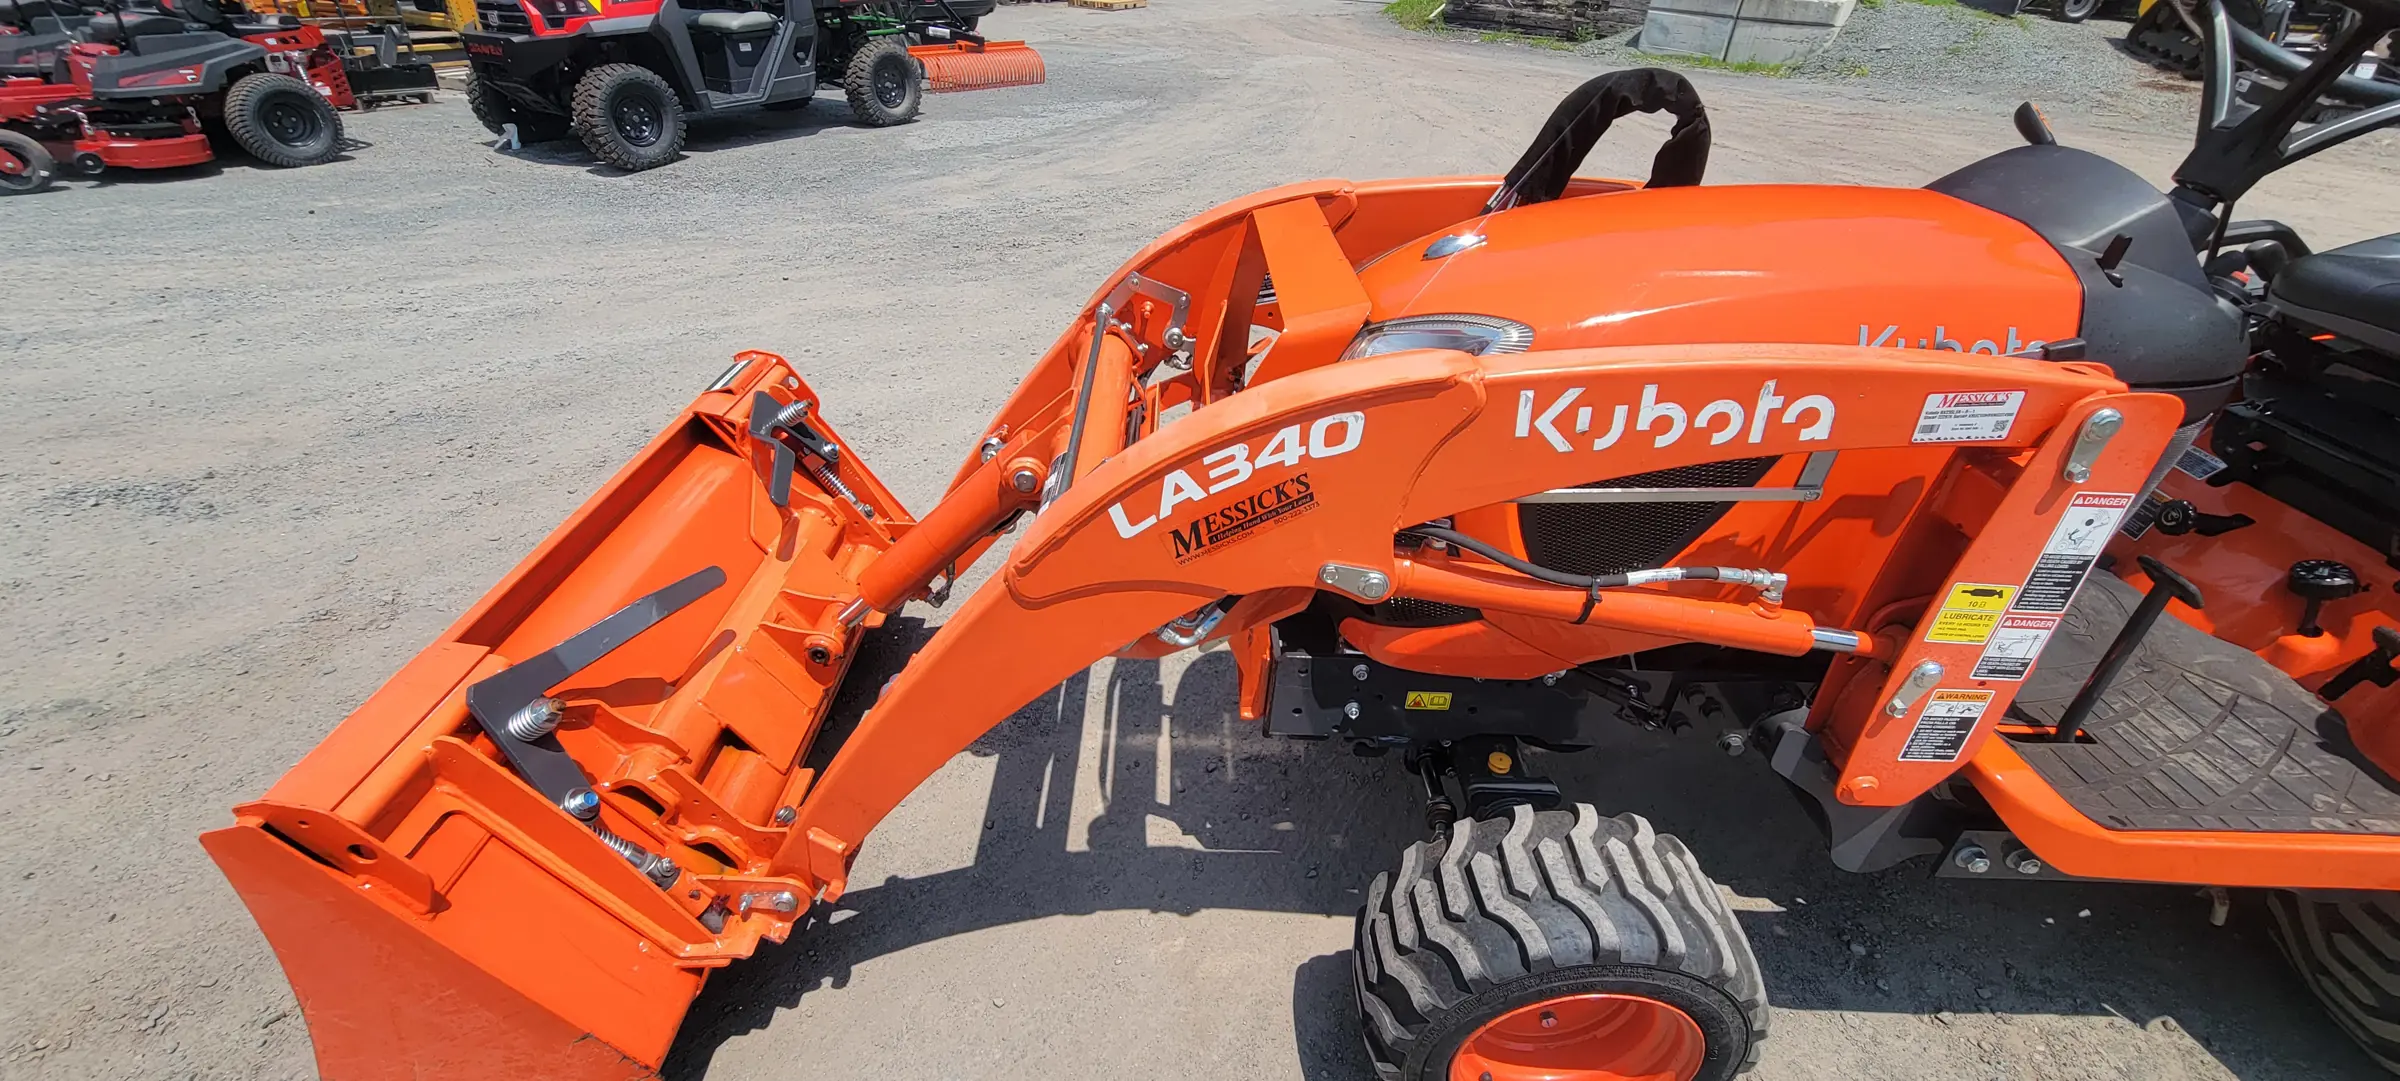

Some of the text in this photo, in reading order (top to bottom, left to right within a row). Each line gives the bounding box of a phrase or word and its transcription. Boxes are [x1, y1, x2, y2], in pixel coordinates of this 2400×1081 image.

[1936, 393, 2012, 408] MESSICK'S
[1515, 378, 1835, 453] Kubota
[1108, 410, 1365, 539] LA340
[2083, 496, 2128, 506] DANGER
[1169, 473, 1311, 559] MESSICK'S
[1217, 526, 1242, 542] Helping
[1243, 518, 1260, 531] Hand
[1277, 503, 1293, 517] Your
[1294, 496, 1311, 509] Land
[1178, 530, 1255, 566] WWW.MESSICKS.COM
[1944, 612, 1995, 621] LUBRICATE
[2012, 619, 2054, 628] DANGER
[1944, 693, 1989, 701] WARNING
